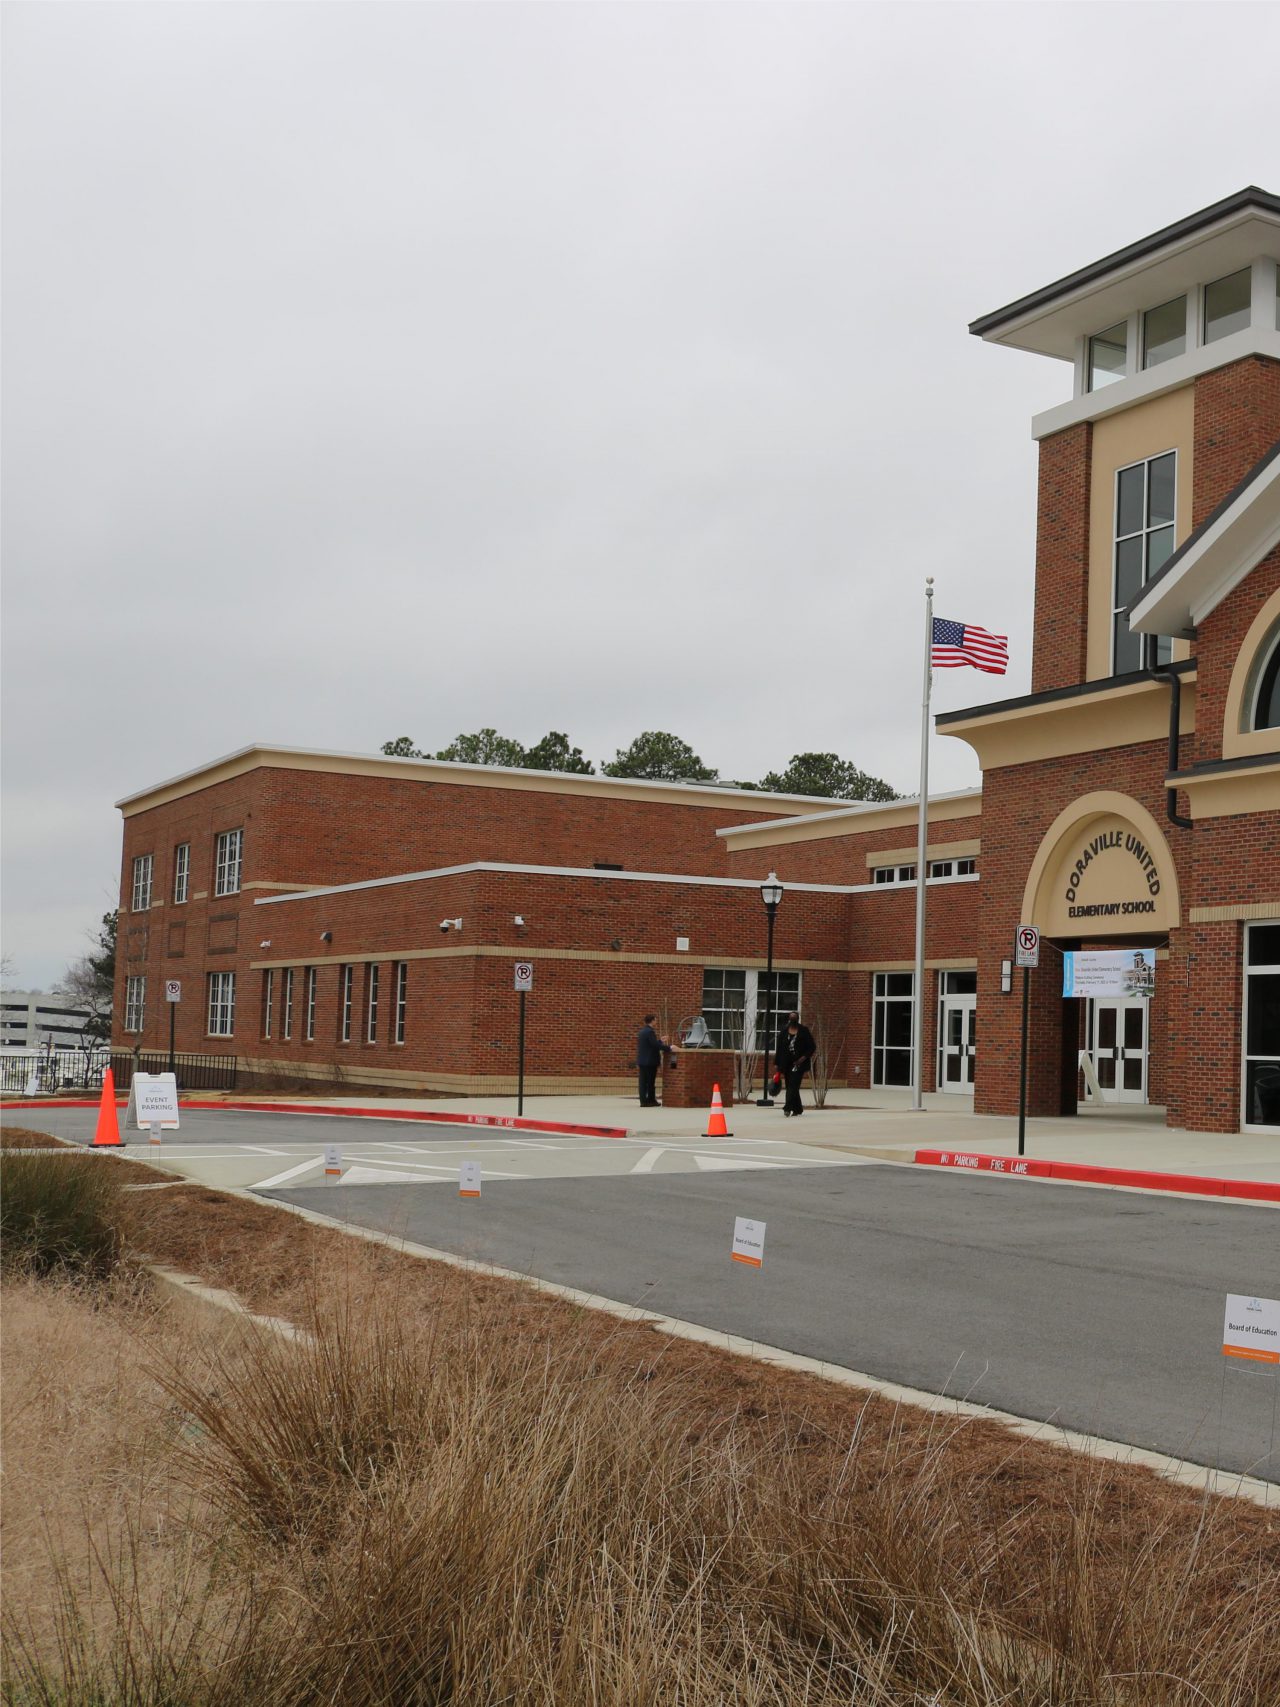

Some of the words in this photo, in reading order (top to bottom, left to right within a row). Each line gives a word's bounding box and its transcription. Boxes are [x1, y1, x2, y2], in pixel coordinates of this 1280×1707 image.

[1065, 831, 1123, 903] DORAVILLE
[1125, 833, 1160, 896] UNITED
[1068, 903, 1120, 918] ELEMENTARY
[1121, 900, 1156, 914] SCHOOL
[953, 1154, 979, 1168] PARKING
[990, 1159, 1005, 1171] FIRE
[1010, 1160, 1028, 1174] LANE
[1228, 1322, 1245, 1332] Board
[1245, 1325, 1251, 1333] of
[1251, 1326, 1278, 1336] Education
